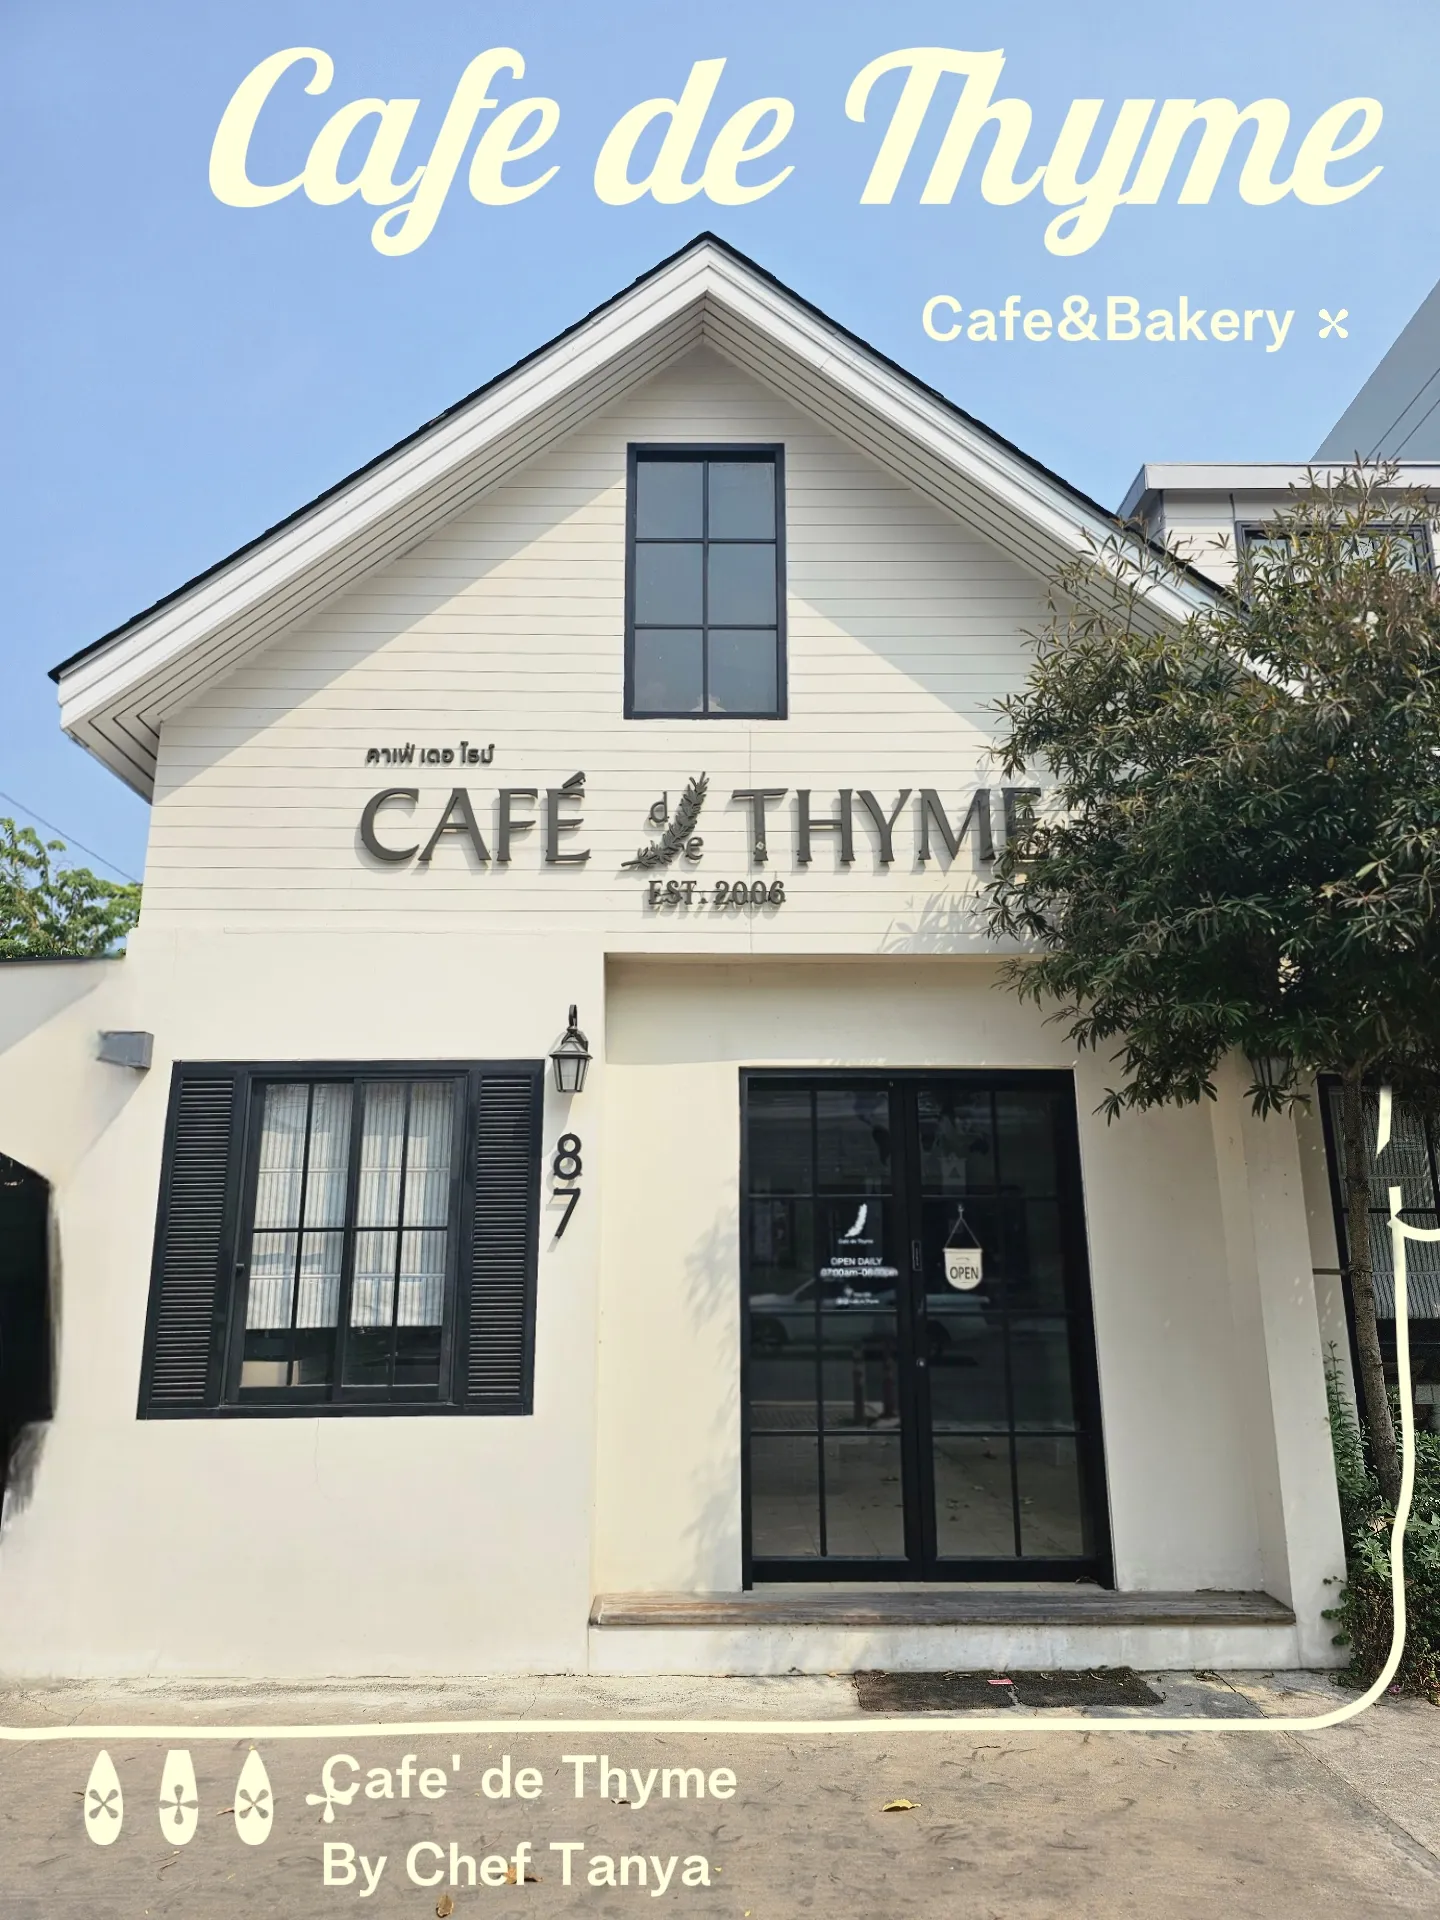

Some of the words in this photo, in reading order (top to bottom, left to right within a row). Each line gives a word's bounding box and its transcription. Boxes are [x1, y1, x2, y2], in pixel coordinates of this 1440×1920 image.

[360, 771, 592, 862] CAFÉ
[830, 1257, 856, 1266] OPEN
[857, 1257, 883, 1266] DAILY
[949, 1266, 979, 1280] OPEN
